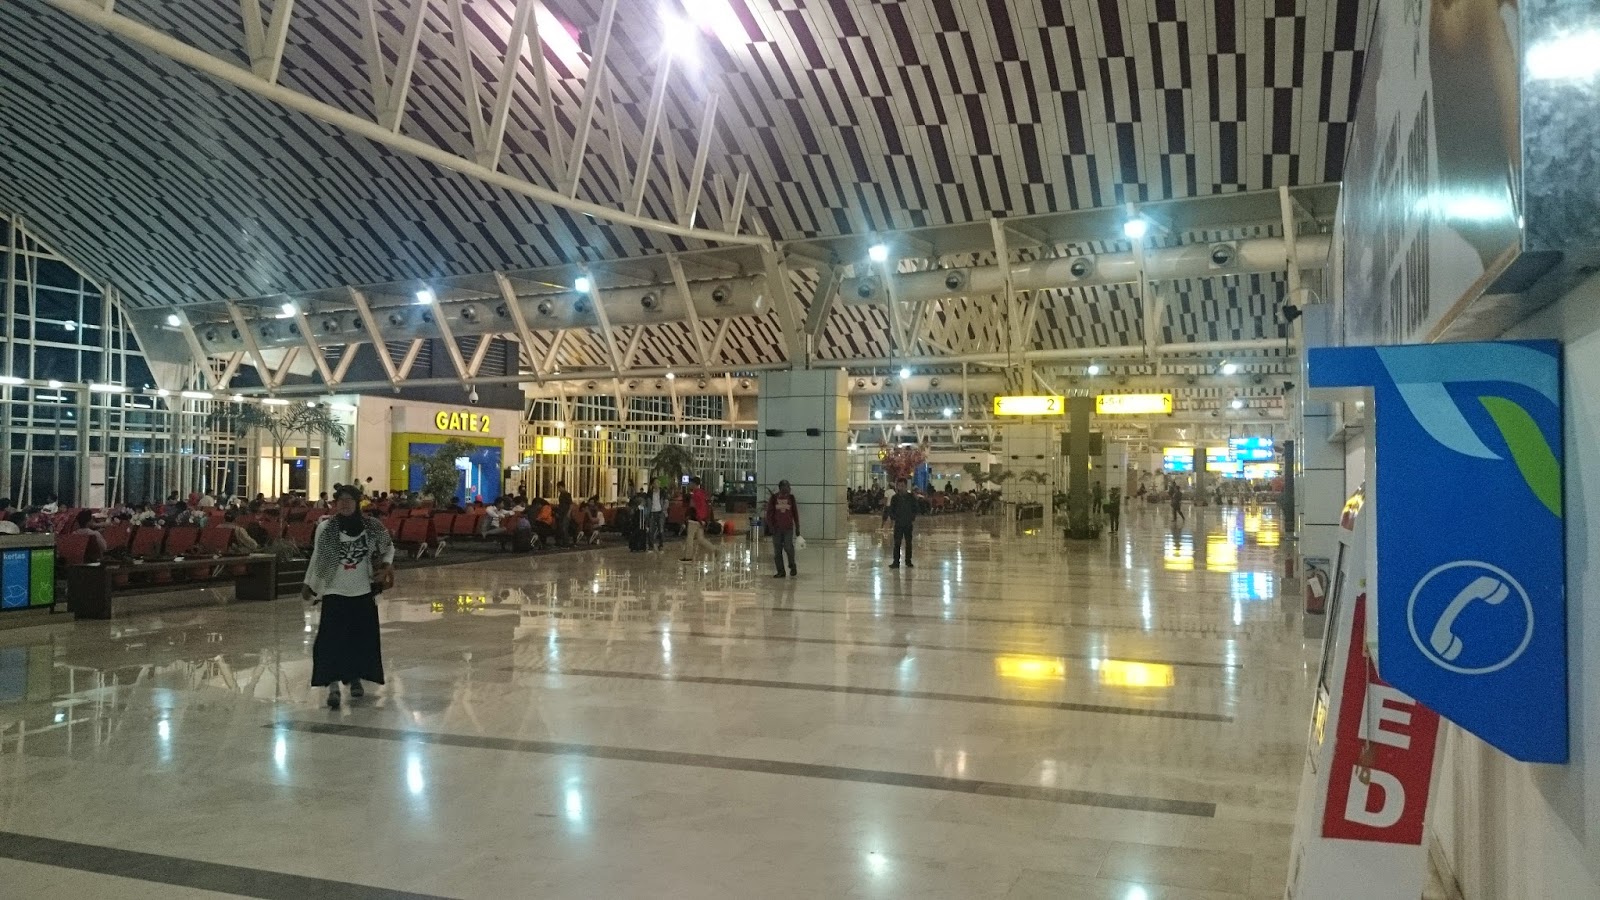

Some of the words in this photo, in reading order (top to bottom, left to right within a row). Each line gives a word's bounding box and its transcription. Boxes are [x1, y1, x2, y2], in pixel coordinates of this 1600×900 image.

[1047, 398, 1055, 411] 2
[435, 410, 478, 432] GATE
[480, 414, 490, 433] 2
